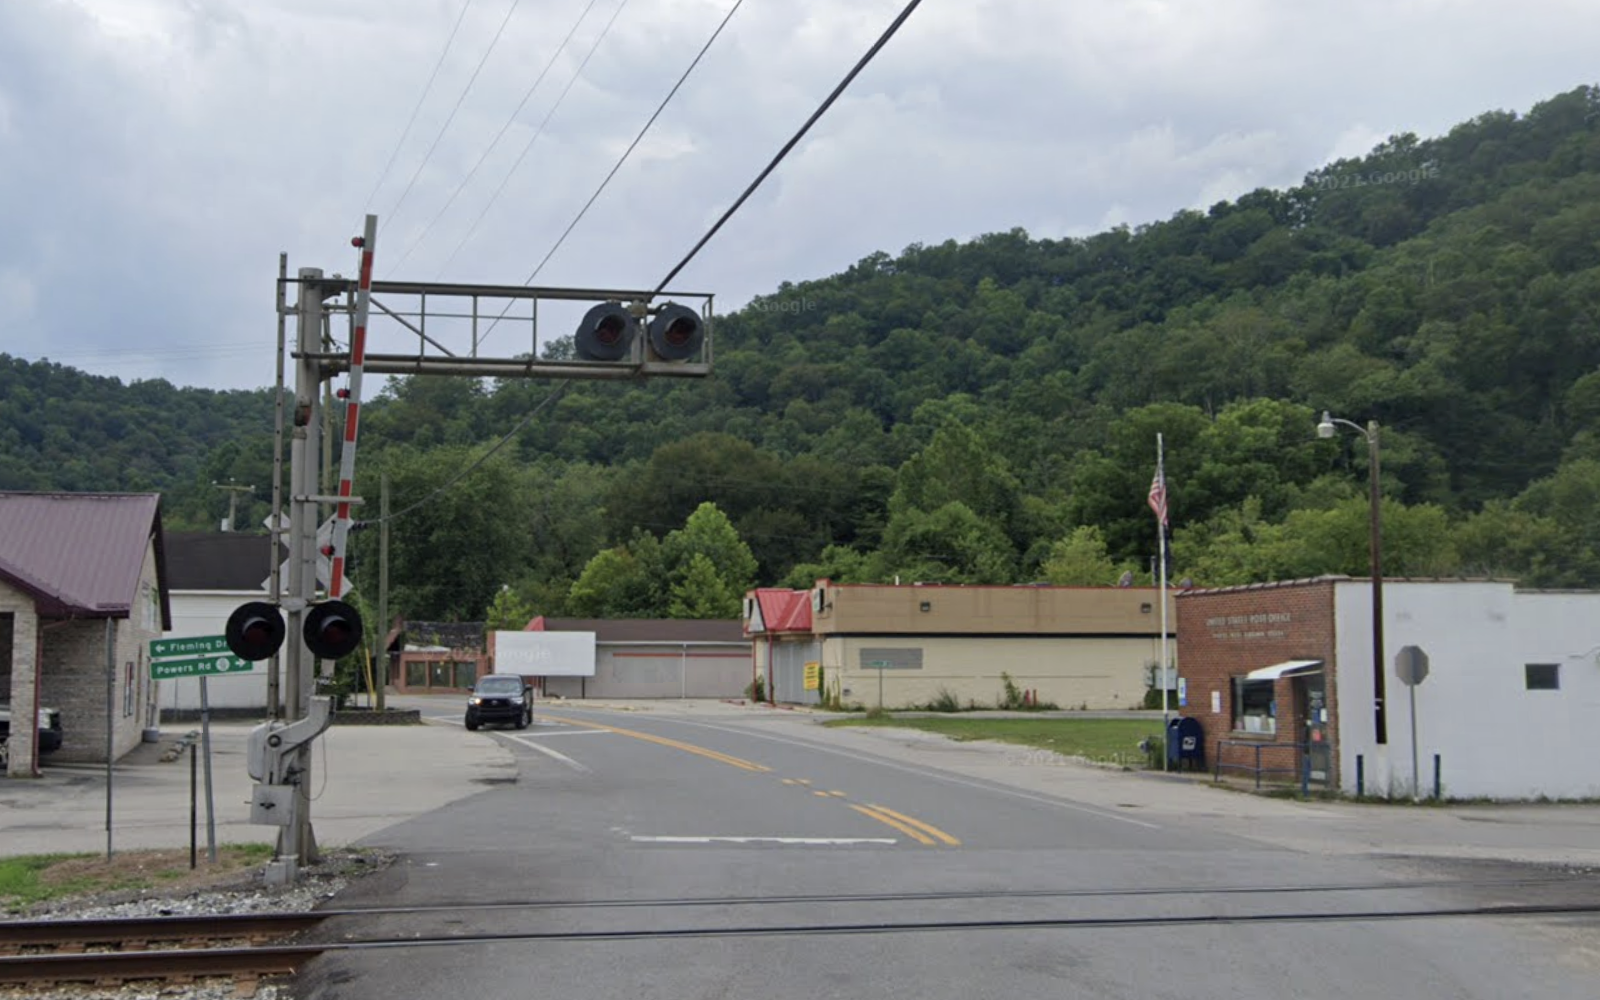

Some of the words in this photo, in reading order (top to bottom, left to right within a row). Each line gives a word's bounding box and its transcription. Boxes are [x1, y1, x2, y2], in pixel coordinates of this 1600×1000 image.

[170, 641, 212, 651] Fleming
[156, 664, 194, 675] Powers
[198, 662, 212, 671] Rd
